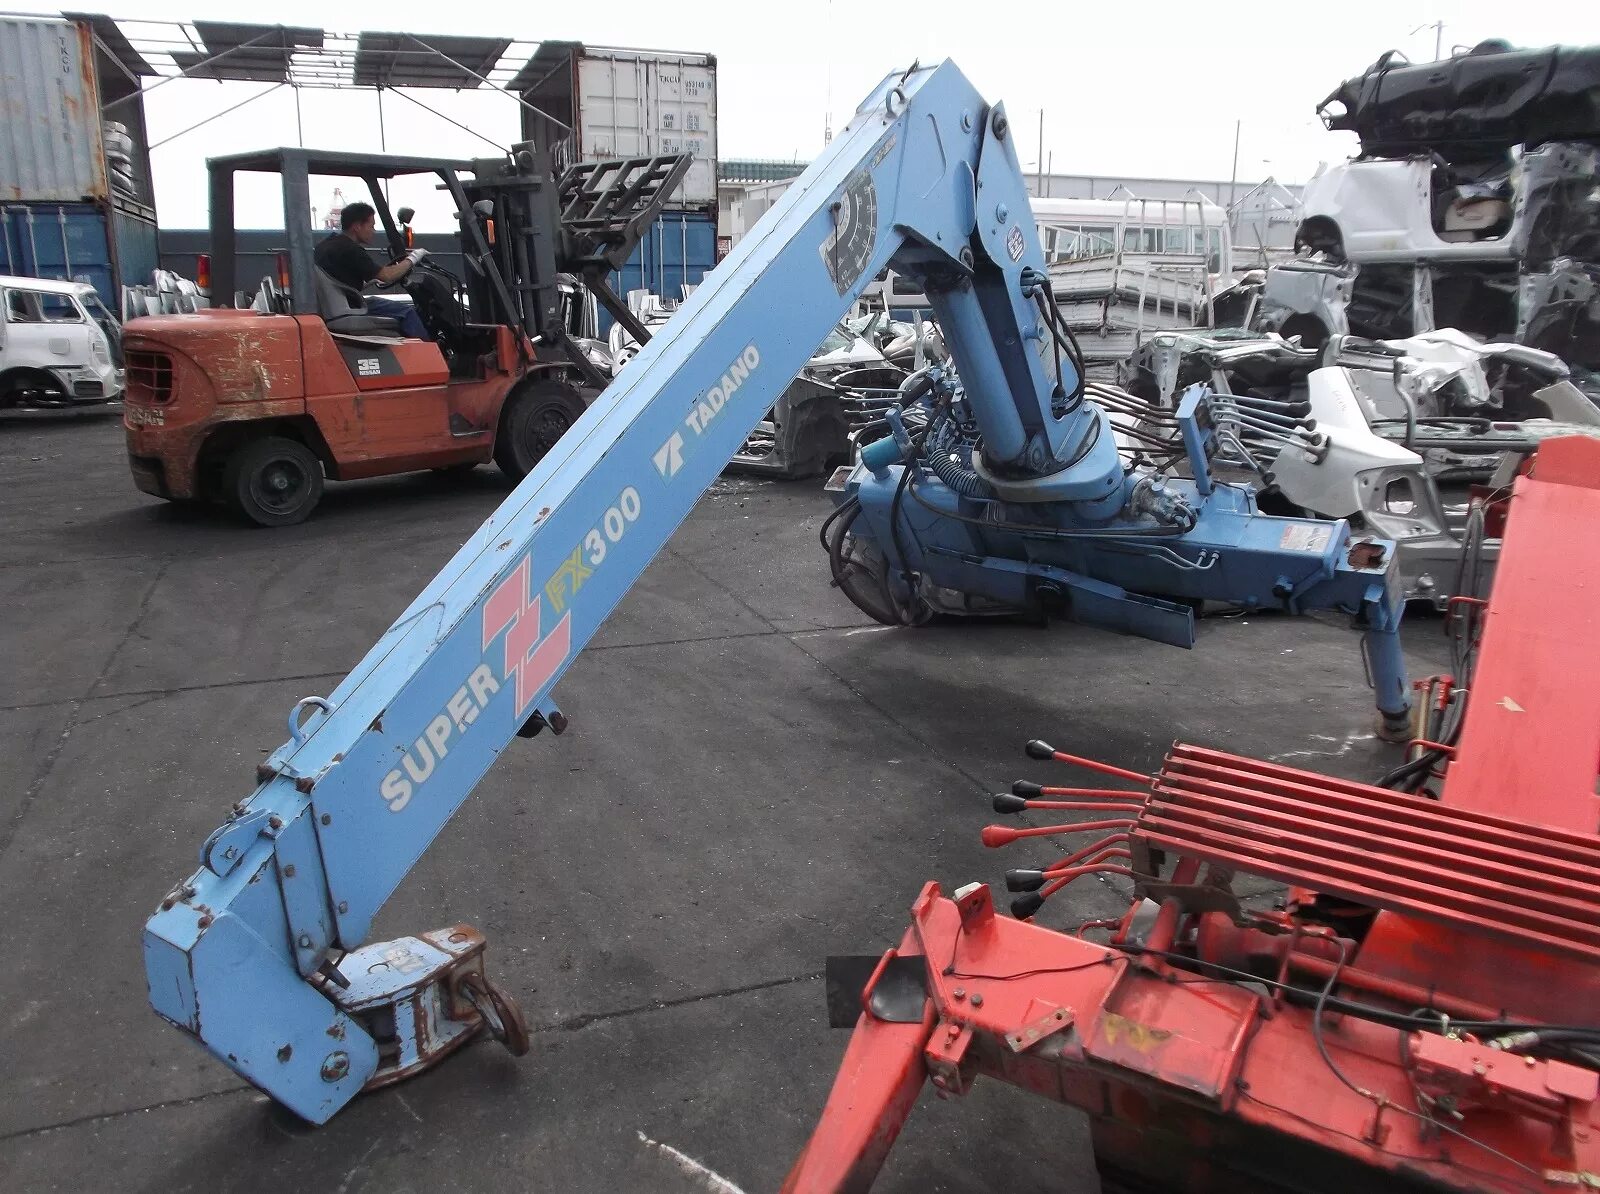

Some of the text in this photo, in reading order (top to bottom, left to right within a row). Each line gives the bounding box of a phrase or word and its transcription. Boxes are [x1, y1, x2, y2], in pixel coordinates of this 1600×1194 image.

[60, 37, 70, 73] TKCU
[358, 358, 380, 370] 35
[685, 345, 760, 434] TADANO
[380, 663, 500, 812] SUPER
